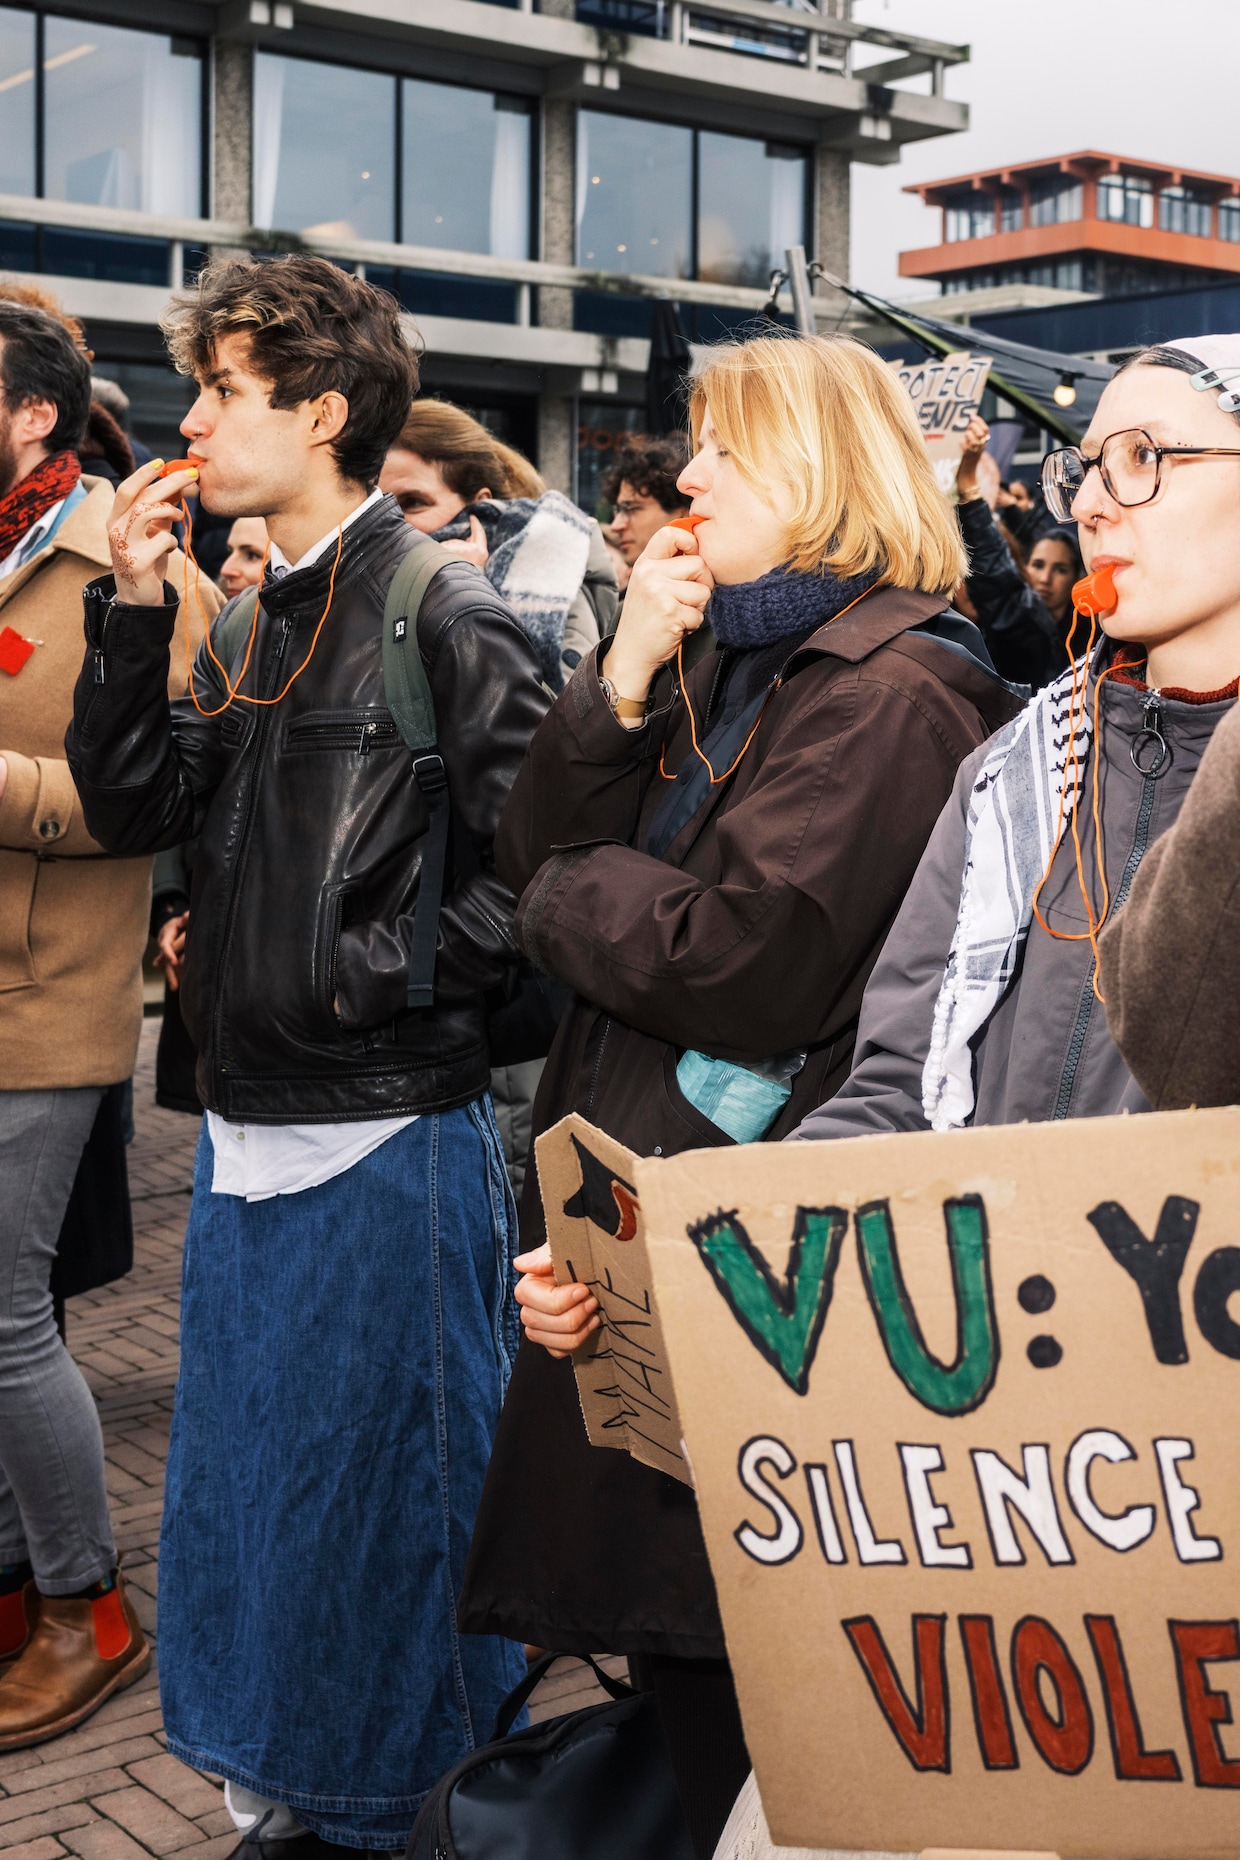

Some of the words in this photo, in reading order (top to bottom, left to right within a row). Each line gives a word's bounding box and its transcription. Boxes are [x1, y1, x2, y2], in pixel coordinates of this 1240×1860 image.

[919, 399, 979, 432] ENTS
[566, 1259, 683, 1460] MAKE
[687, 1193, 1064, 1416] VU:
[733, 1427, 1223, 1569] SILENCE
